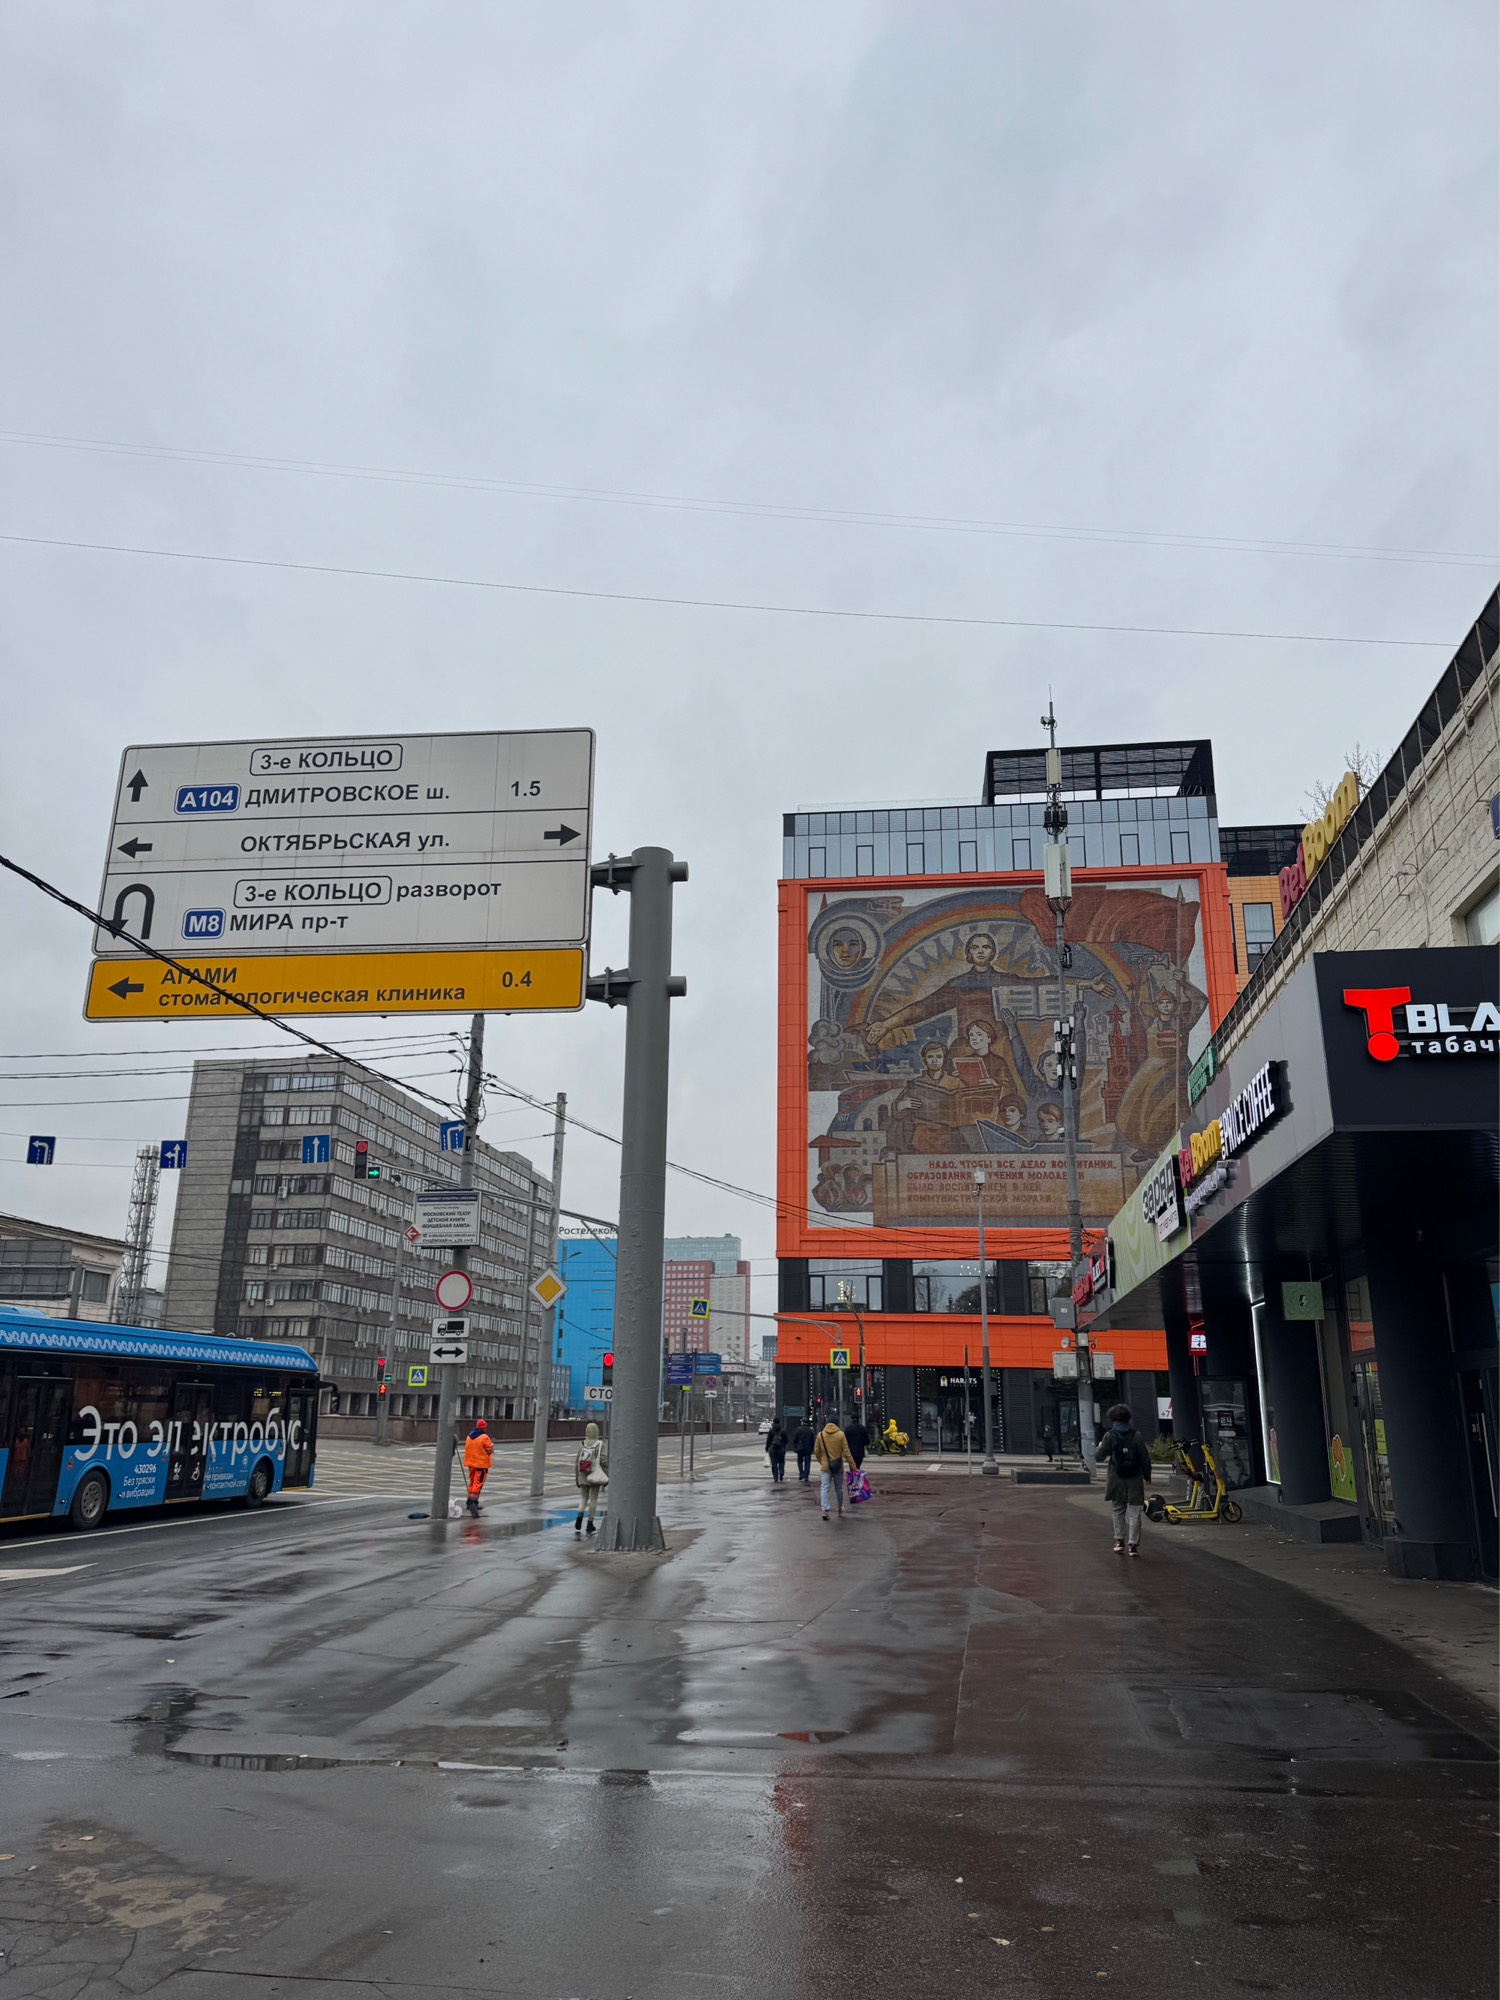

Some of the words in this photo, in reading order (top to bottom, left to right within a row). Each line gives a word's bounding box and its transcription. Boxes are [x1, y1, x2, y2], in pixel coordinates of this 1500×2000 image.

[260, 754, 291, 770] 3-е
[298, 750, 393, 769] КОЛЬЦО
[180, 789, 234, 808] А104
[245, 784, 419, 808] ДМИТРОВСКОЕ
[426, 787, 450, 800] ш.
[511, 781, 541, 797] 1.5
[240, 831, 411, 853] ОКТЯБРЬСКАЯ
[417, 834, 450, 852] ул.
[1278, 771, 1360, 920] BetBoom
[245, 885, 277, 902] 3-е
[284, 882, 382, 902] КОЛЬЦО
[396, 883, 502, 902] разворот
[188, 915, 220, 933] М8
[229, 913, 294, 931] МИРА
[301, 915, 348, 933] пр-т
[501, 970, 532, 988] 0.4
[158, 989, 369, 1006] стоматологическая
[376, 987, 465, 1002] клиника
[1411, 1035, 1499, 1054] табач
[1221, 1093, 1247, 1157] PRICE
[1243, 1061, 1275, 1137] COFFEE
[1178, 1119, 1222, 1189] BetBoom
[959, 1159, 992, 1169] ЧТОБЫ
[996, 1160, 1015, 1169] ВСЕ
[1020, 1160, 1046, 1169] ДЕЛО
[1028, 1171, 1085, 1180] МОЛОДЕИ
[950, 1377, 977, 1385] HARTS
[589, 1388, 613, 1400] СТО
[74, 1405, 138, 1461] Это
[134, 1463, 157, 1474] 430296
[123, 1476, 135, 1487] Без
[135, 1475, 156, 1487] тряски
[125, 1485, 155, 1499] вибраций
